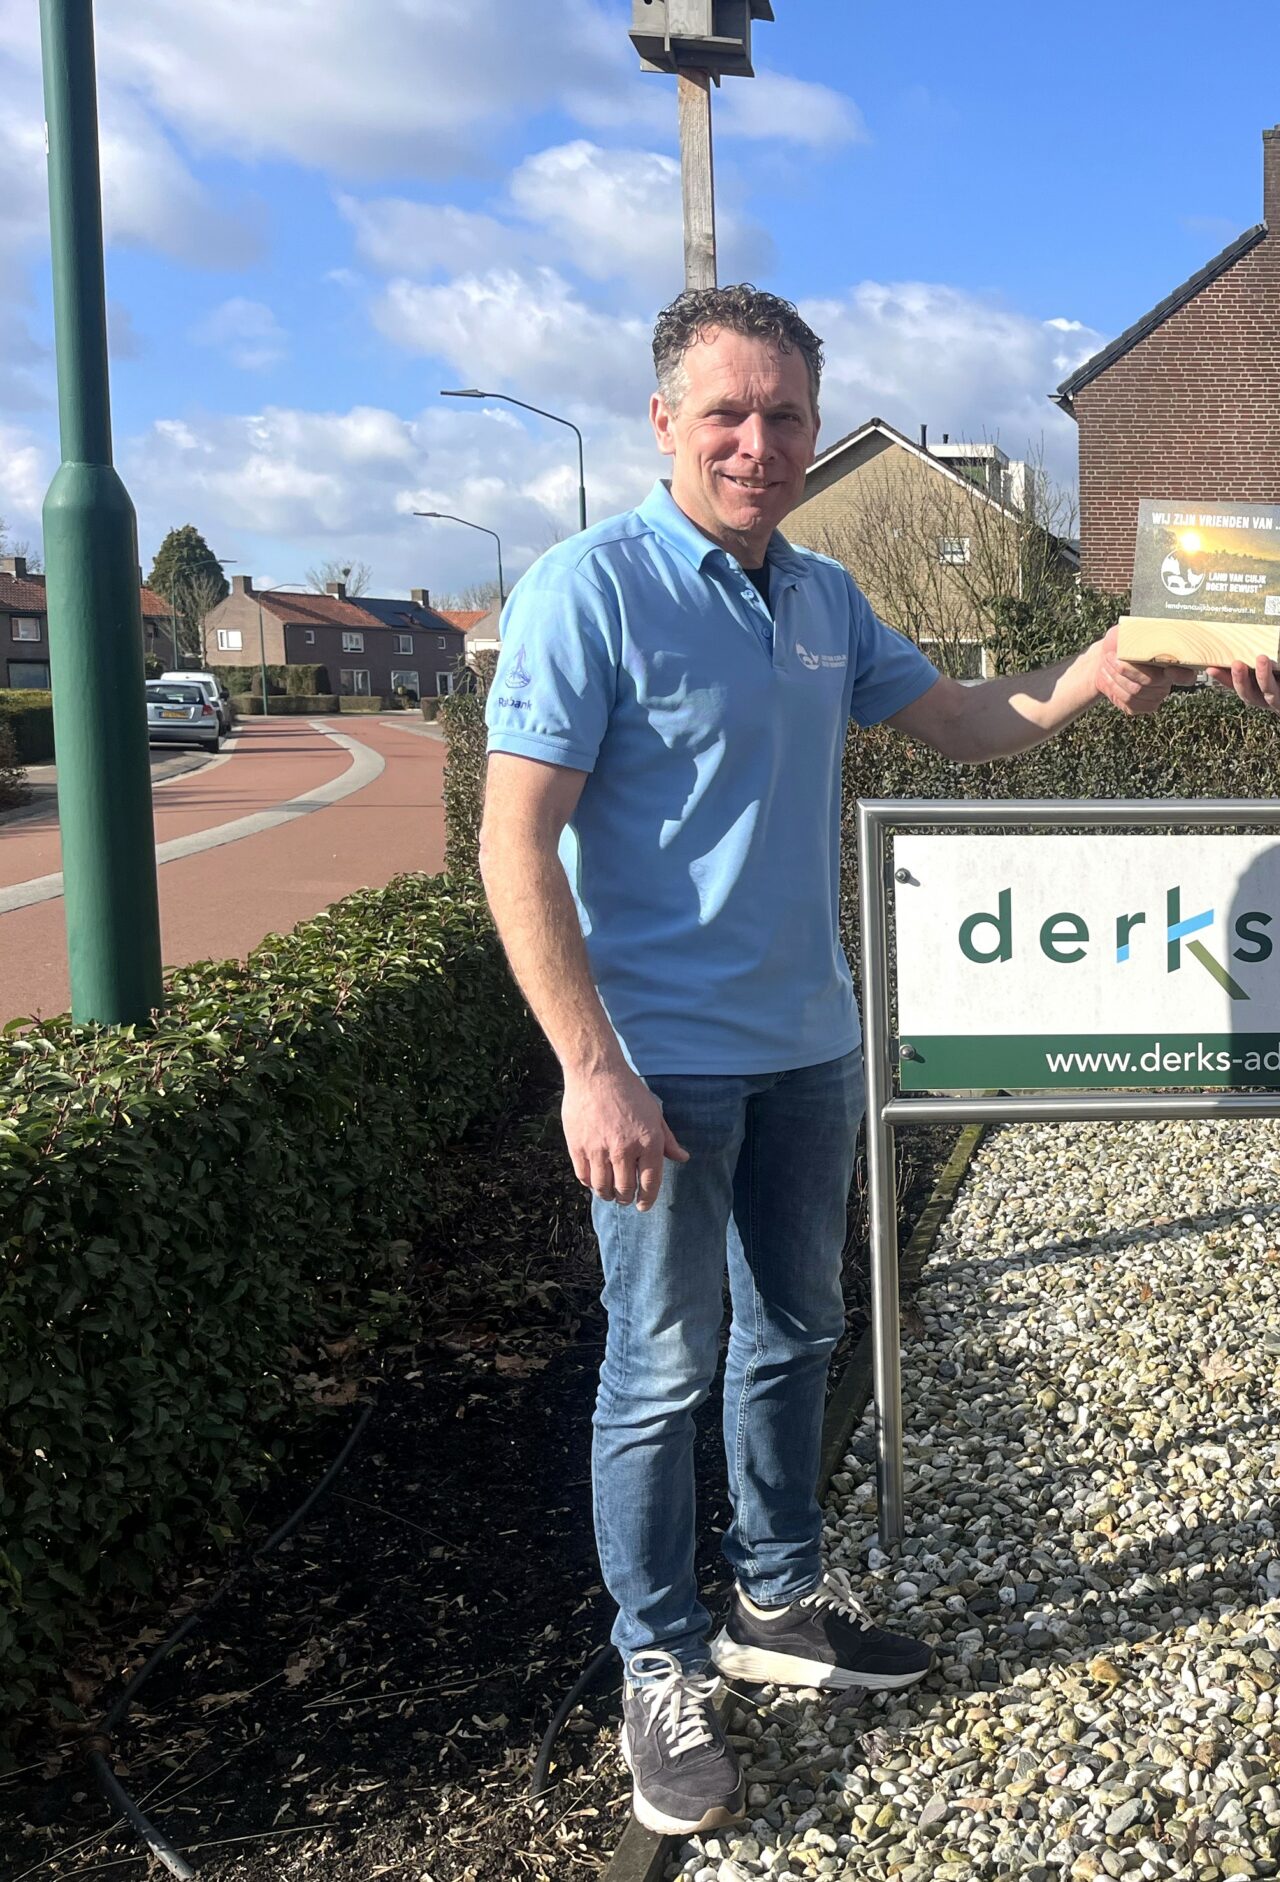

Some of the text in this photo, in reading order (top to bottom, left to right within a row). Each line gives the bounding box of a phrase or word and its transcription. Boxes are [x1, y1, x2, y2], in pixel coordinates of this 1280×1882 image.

[1152, 512, 1171, 525] WIJ
[1173, 514, 1196, 526] ZIJN
[1199, 515, 1250, 529] VRIENDEN
[1252, 517, 1273, 530] VAN
[1208, 572, 1267, 584] LAND VAN CUIJK
[1205, 582, 1228, 592] BOERT
[957, 885, 1274, 1000] derks
